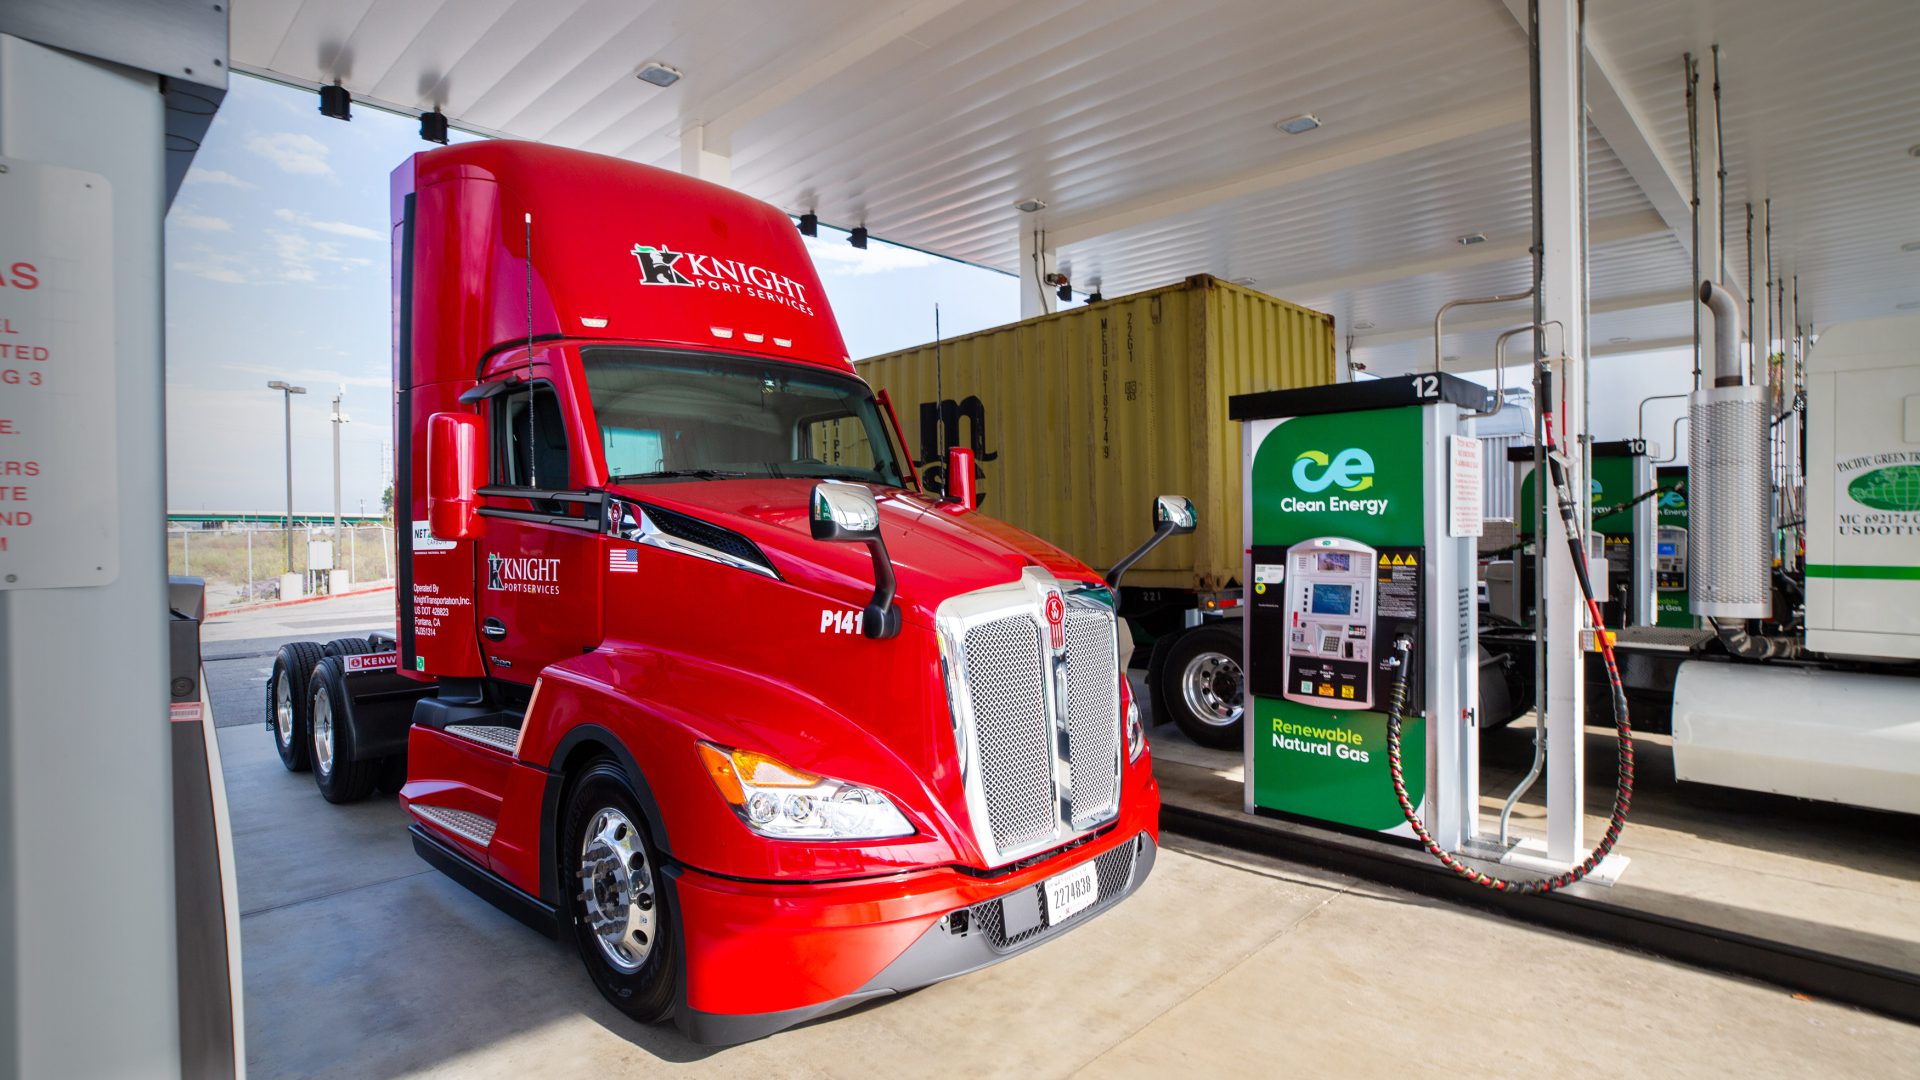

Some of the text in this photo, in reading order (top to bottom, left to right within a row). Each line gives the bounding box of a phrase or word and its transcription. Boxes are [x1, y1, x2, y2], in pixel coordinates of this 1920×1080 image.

[684, 252, 808, 304] KNIGHT
[697, 278, 815, 317] PORT SERVICES
[1127, 312, 1135, 362] 22G1
[29, 372, 42, 386] 3
[1411, 375, 1439, 398] 12
[1628, 442, 1645, 454] 10
[1837, 456, 1873, 472] PACIFIC
[1874, 452, 1906, 465] GREEN
[1280, 496, 1389, 516] Clean Energy
[1839, 514, 1861, 524] MC
[1865, 514, 1909, 524] 692174
[504, 558, 560, 582] KNIGHT
[504, 582, 560, 595] PORT SERVICES
[422, 606, 431, 615] DOT
[433, 618, 440, 627] CA
[820, 610, 864, 635] P141
[1272, 718, 1363, 746] Renewable
[1272, 734, 1370, 763] Natural Gas
